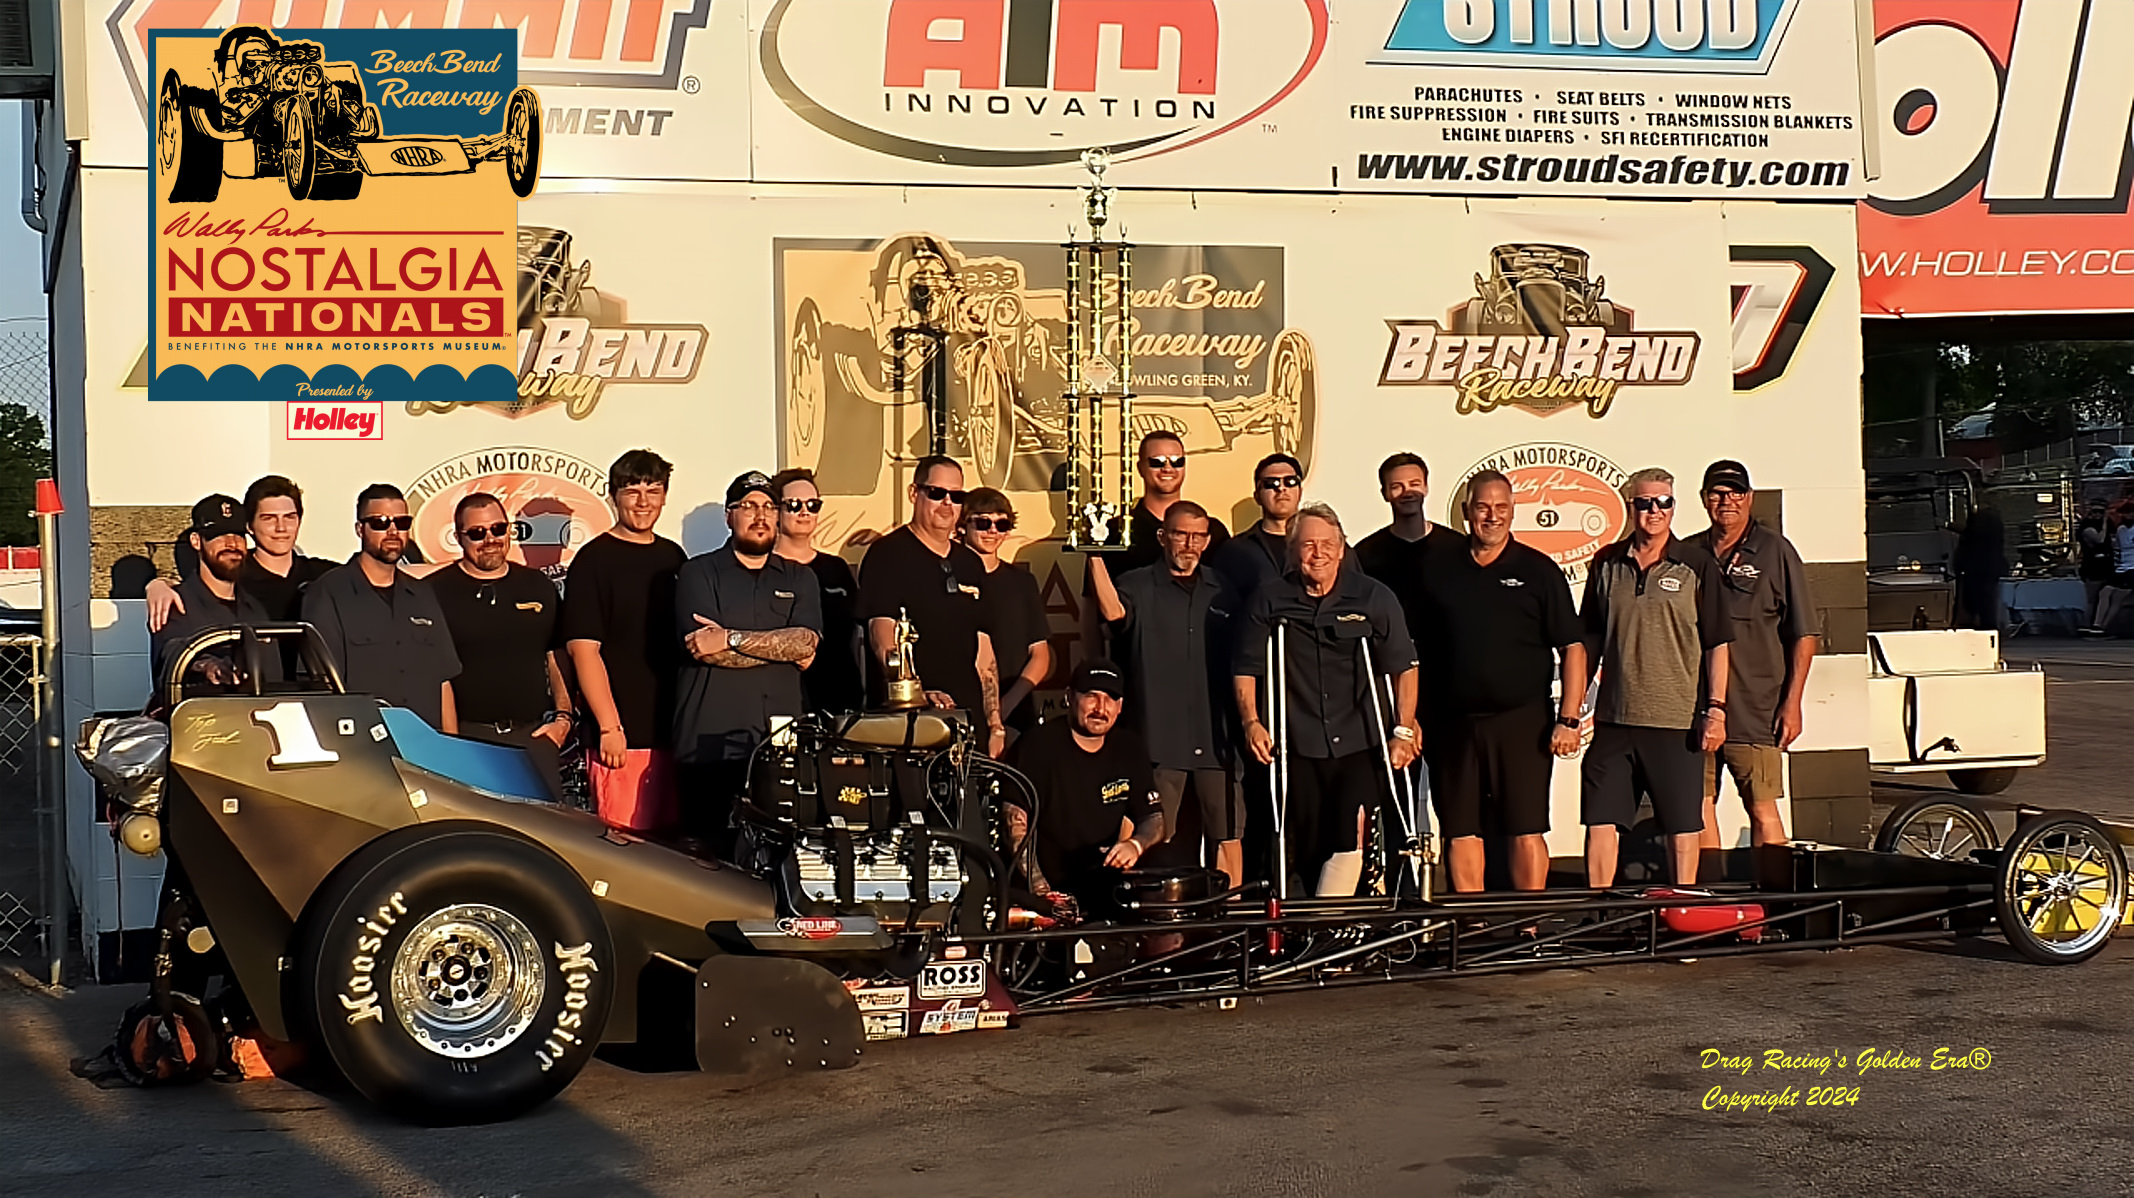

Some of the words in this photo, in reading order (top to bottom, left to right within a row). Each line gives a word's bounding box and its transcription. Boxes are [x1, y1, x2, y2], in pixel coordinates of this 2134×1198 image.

[884, 92, 1215, 119] INNOVATION
[1414, 86, 1523, 103] PARACHUTES
[1556, 91, 1594, 106] SEAT
[1599, 92, 1646, 107] BELTS
[1675, 93, 1749, 109] WINDOW
[1753, 96, 1792, 110] NETS
[1350, 105, 1386, 120] FIRE
[1390, 106, 1507, 123] SUPPRESSION
[1533, 110, 1568, 125] FIRE
[1571, 111, 1620, 126] SUITS
[1646, 112, 1769, 129] TRANSMISSION
[1774, 114, 1853, 130] BLANKETS
[1441, 127, 1500, 142] ENGINE
[1505, 128, 1575, 144] DIAPERS
[1601, 131, 1625, 146] SFI
[1630, 132, 1769, 148] RECERTIFICATION
[1358, 153, 1850, 188] www.stroudsafety.com
[1175, 274, 1265, 310] Bend
[1560, 326, 1694, 381] BEND
[1181, 374, 1230, 388] GREEN,
[1233, 374, 1253, 387] KY.
[1457, 367, 1616, 412] Raceway
[418, 461, 472, 499] NHRA
[477, 452, 609, 498] MOTORSPORTS
[1513, 447, 1627, 488] MOTORSPORTS
[510, 524, 527, 540] 51
[1539, 512, 1556, 525] 51
[249, 700, 341, 773] 1
[923, 965, 981, 987] ROSS
